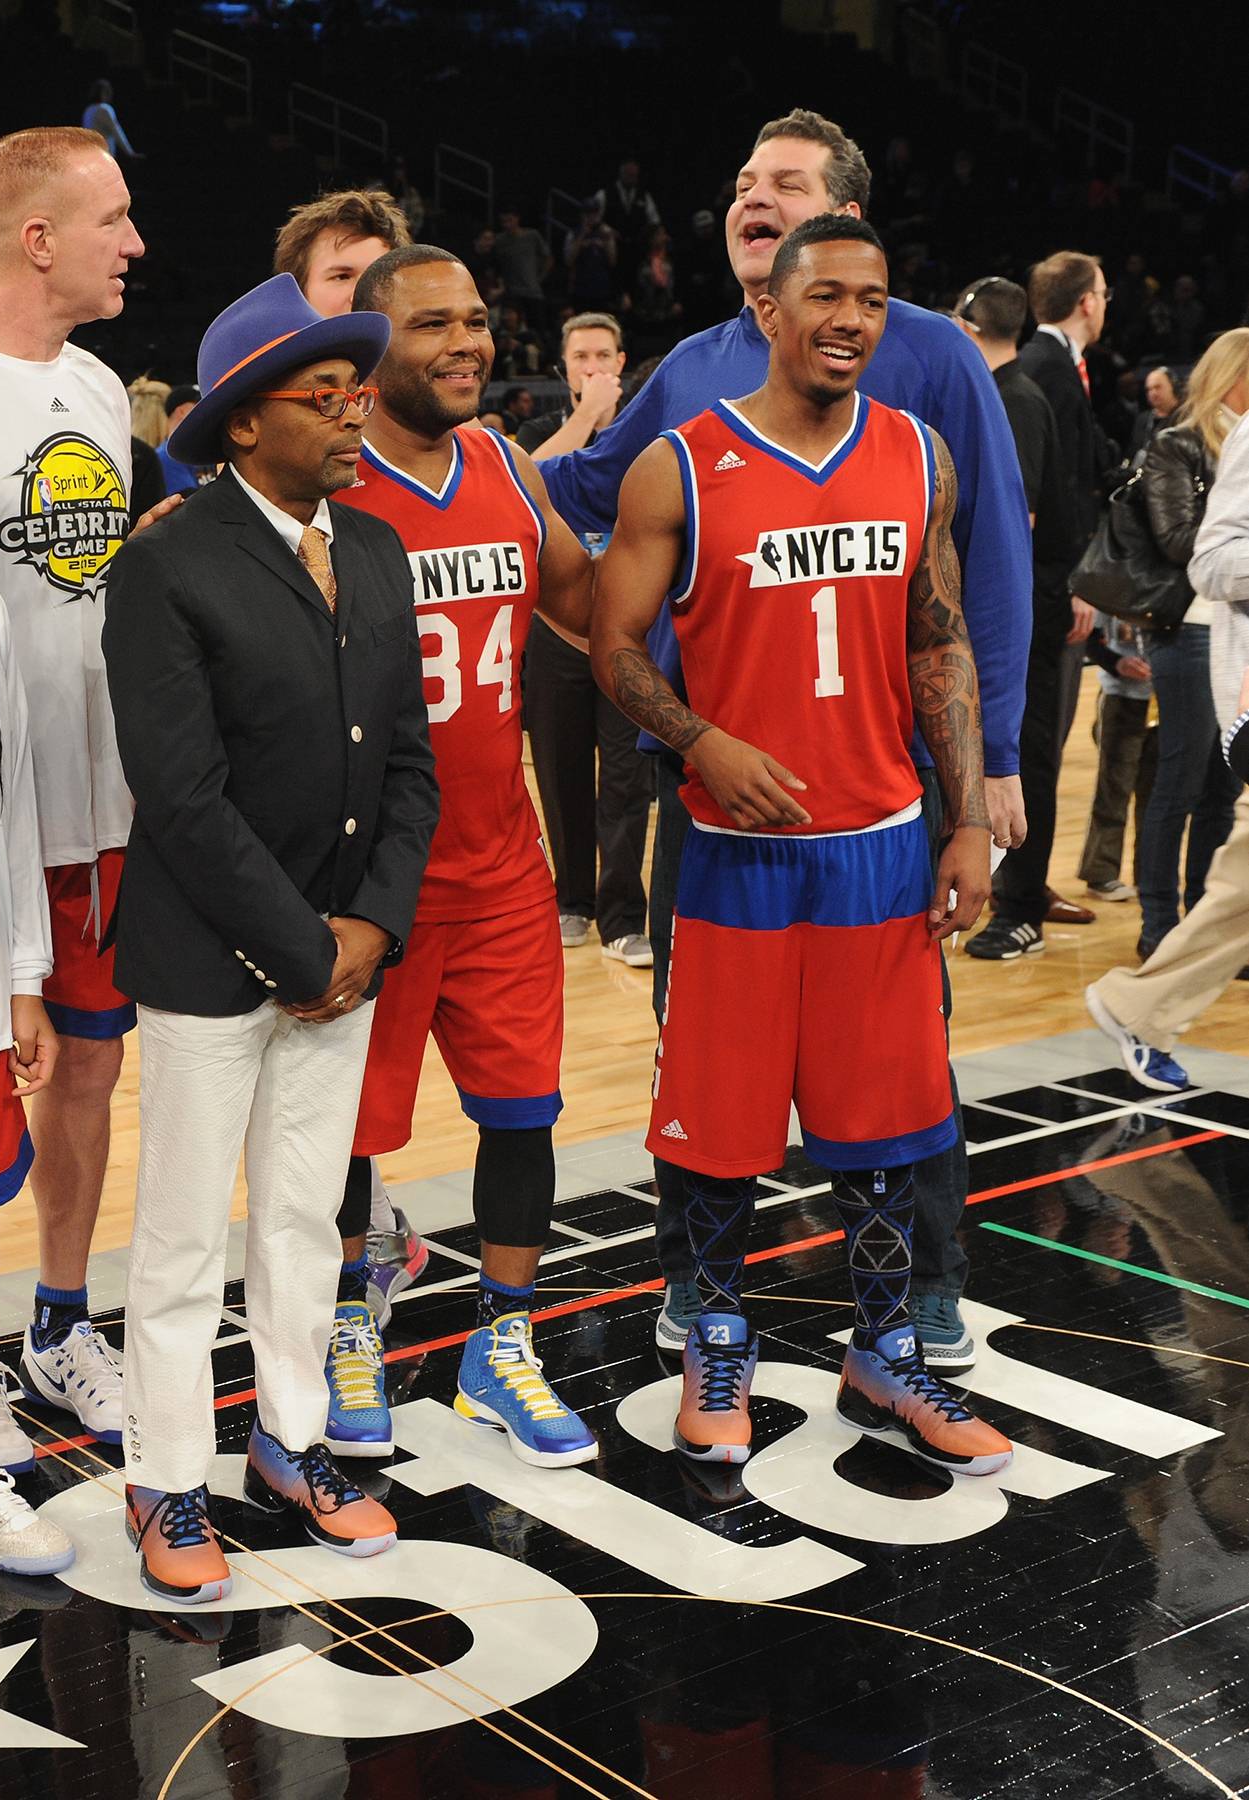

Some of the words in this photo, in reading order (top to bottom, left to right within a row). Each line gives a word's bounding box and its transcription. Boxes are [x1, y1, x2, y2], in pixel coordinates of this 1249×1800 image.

[714, 459, 747, 471] adidas
[53, 474, 89, 494] Sprint
[53, 501, 75, 511] ALL
[82, 500, 112, 508] STAR
[53, 539, 106, 557] GAME
[786, 528, 854, 578] NYC
[864, 526, 900, 571] 15
[418, 549, 484, 599] NYC
[489, 546, 522, 592] 15
[811, 586, 844, 698] 1
[416, 604, 514, 723] 34
[660, 1128, 688, 1140] adidas
[707, 1325, 730, 1345] 23
[896, 1335, 917, 1358] 23
